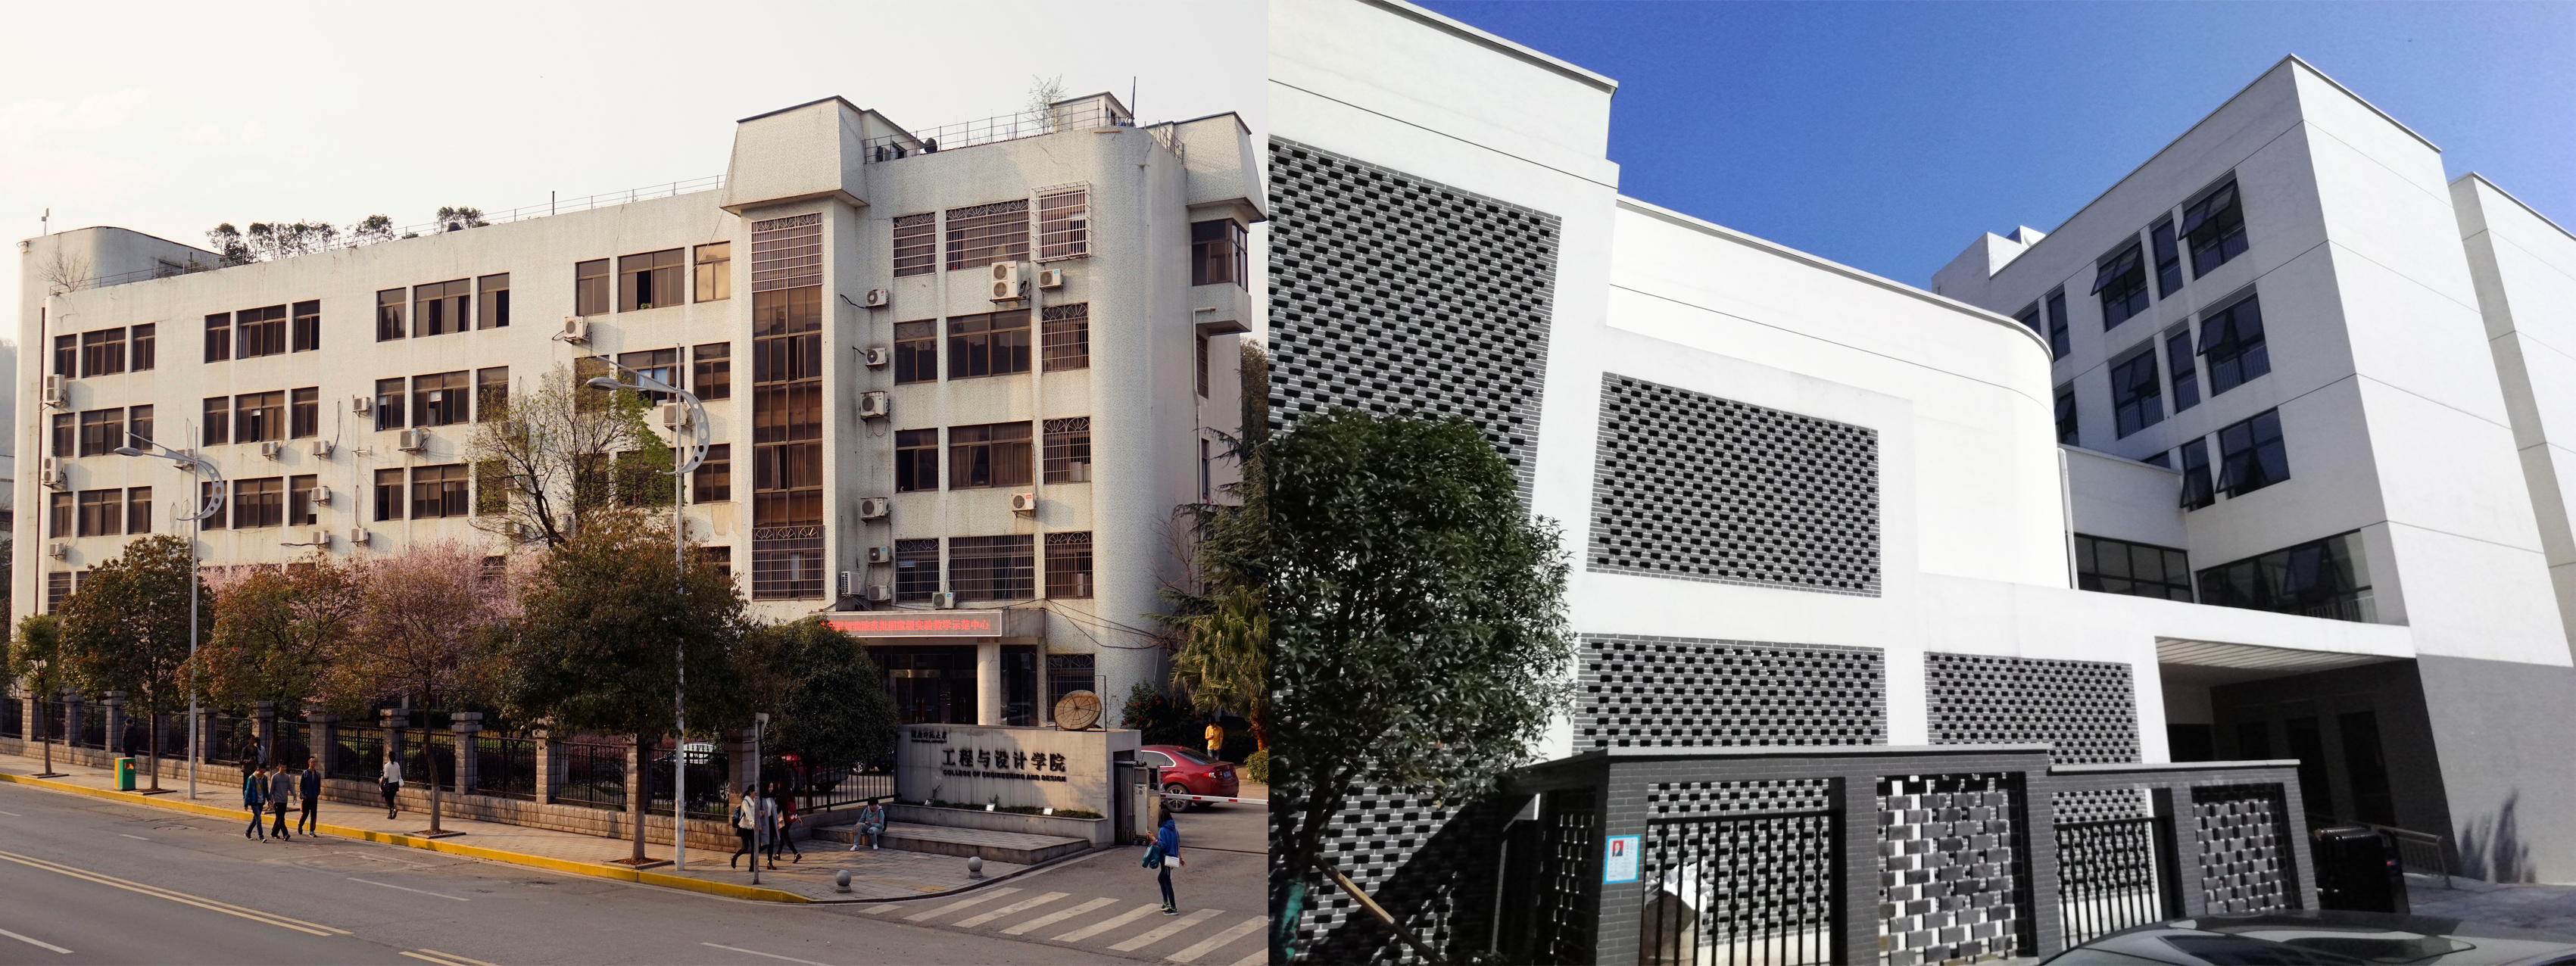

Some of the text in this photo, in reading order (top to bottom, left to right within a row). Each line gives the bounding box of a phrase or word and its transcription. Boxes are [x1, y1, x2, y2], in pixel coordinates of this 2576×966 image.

[942, 749, 1066, 772] 工程与设计学院
[982, 771, 1025, 780] ENGINEERING
